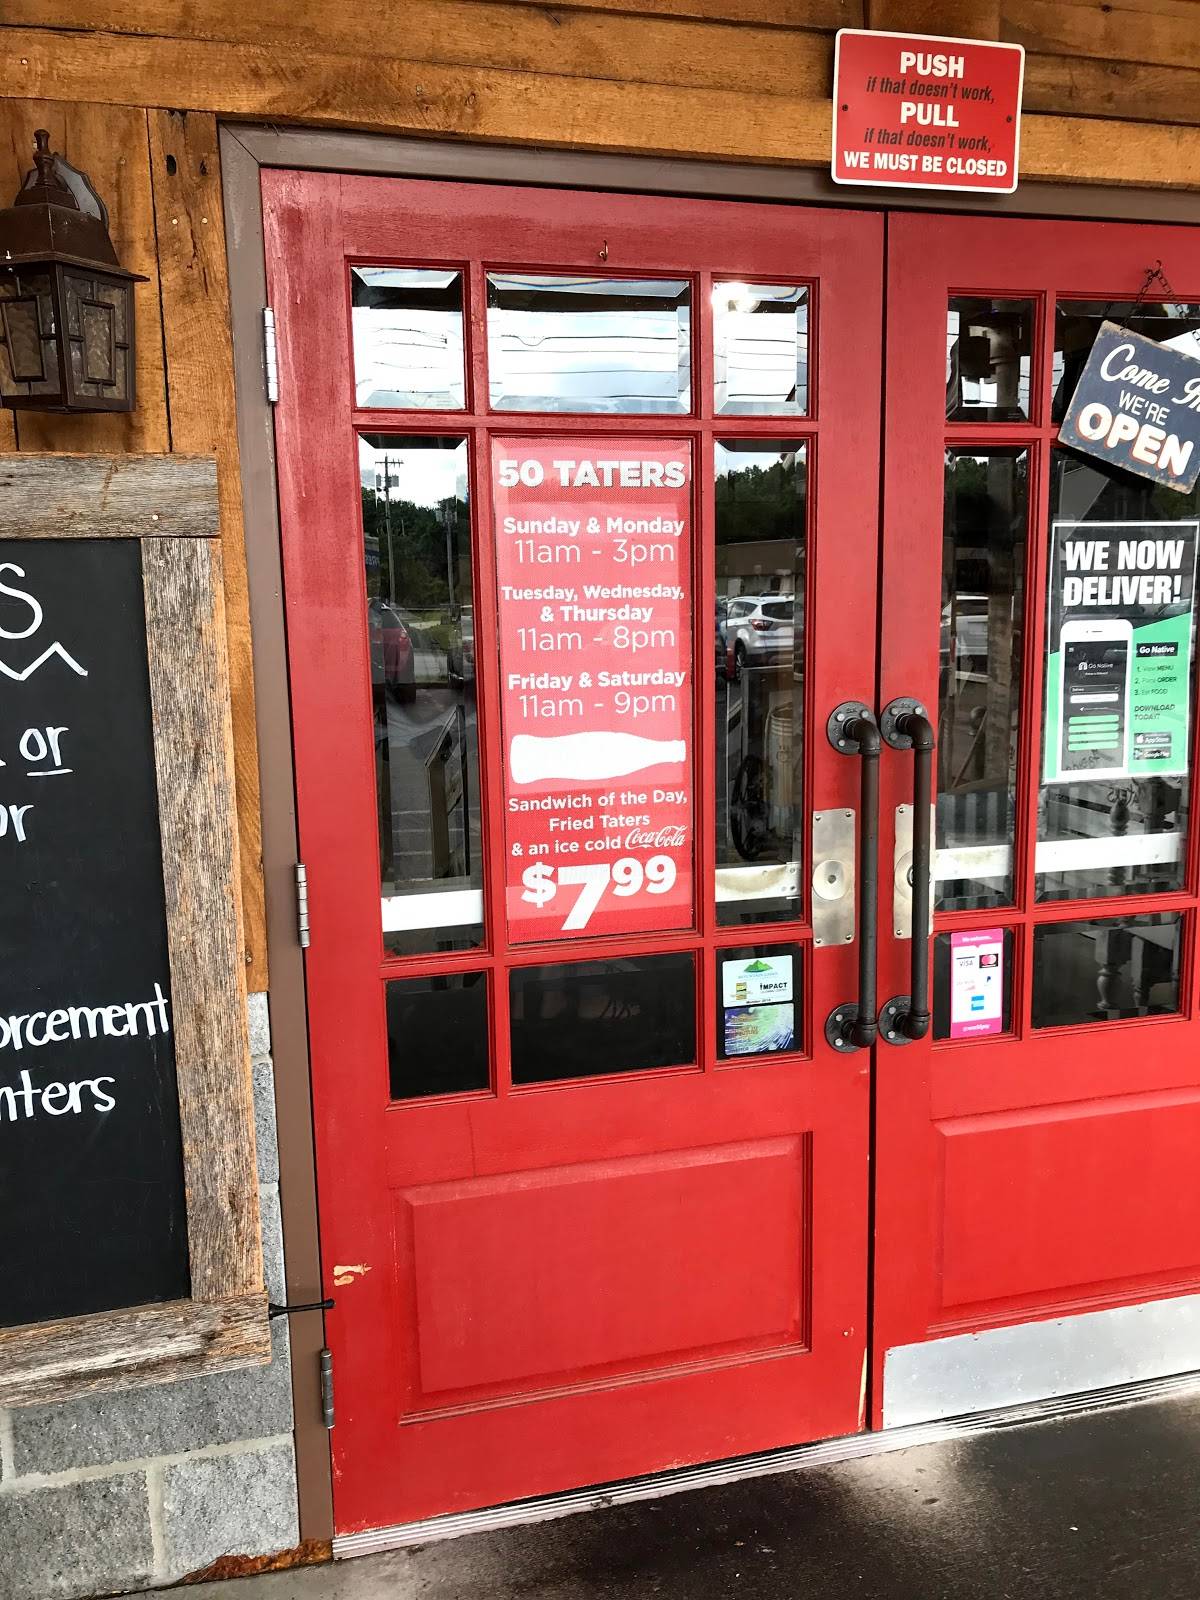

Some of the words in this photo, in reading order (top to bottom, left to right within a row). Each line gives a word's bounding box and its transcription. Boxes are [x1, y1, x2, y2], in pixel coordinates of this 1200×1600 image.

[900, 51, 964, 79] PUSH
[866, 76, 876, 92] if
[880, 77, 906, 94] that
[909, 79, 958, 98] doesn't
[961, 86, 995, 104] work,
[900, 101, 959, 127] PULL
[864, 128, 875, 143] if
[877, 129, 904, 145] that
[906, 130, 955, 149] doesn't
[958, 136, 991, 153] work,
[843, 150, 870, 168] WE
[874, 152, 918, 172] MUST
[922, 156, 943, 173] BE
[946, 157, 1007, 177] CLOSED
[1100, 344, 1170, 394] Come
[1118, 389, 1170, 426] WE'RE
[1076, 402, 1194, 477] OPEN
[498, 459, 544, 487] 50
[552, 459, 686, 488] TATERS
[503, 516, 580, 537] Sunday
[586, 517, 600, 534] &
[606, 516, 684, 537] Monday
[514, 539, 581, 564] 11am
[612, 539, 675, 567] 3pm
[1065, 540, 1110, 571] WE
[1117, 539, 1185, 570] NOW
[501, 586, 578, 602] Tuesday,
[583, 584, 684, 600] Wednesday,
[1063, 575, 1182, 606] DELIVER!
[540, 606, 554, 622] &
[560, 603, 653, 623] Thursday
[517, 627, 582, 651] 11am
[613, 625, 675, 653] 8pm
[1140, 646, 1151, 654] Go
[1151, 644, 1175, 654] Native
[508, 672, 573, 691] Friday
[579, 671, 592, 688] &
[598, 669, 686, 687] Saturday
[519, 694, 583, 718] 11am
[614, 691, 676, 717] 9pm
[1134, 703, 1175, 712] DOWNLOAD
[19, 726, 71, 767] or
[508, 794, 592, 812] Sandwich
[597, 791, 615, 807] of
[620, 791, 647, 805] the
[653, 789, 688, 804] Day,
[549, 816, 594, 831] Fried
[599, 814, 650, 828] Taters
[511, 842, 523, 856] &
[529, 842, 549, 855] an
[554, 839, 580, 853] ice
[585, 836, 621, 851] cold
